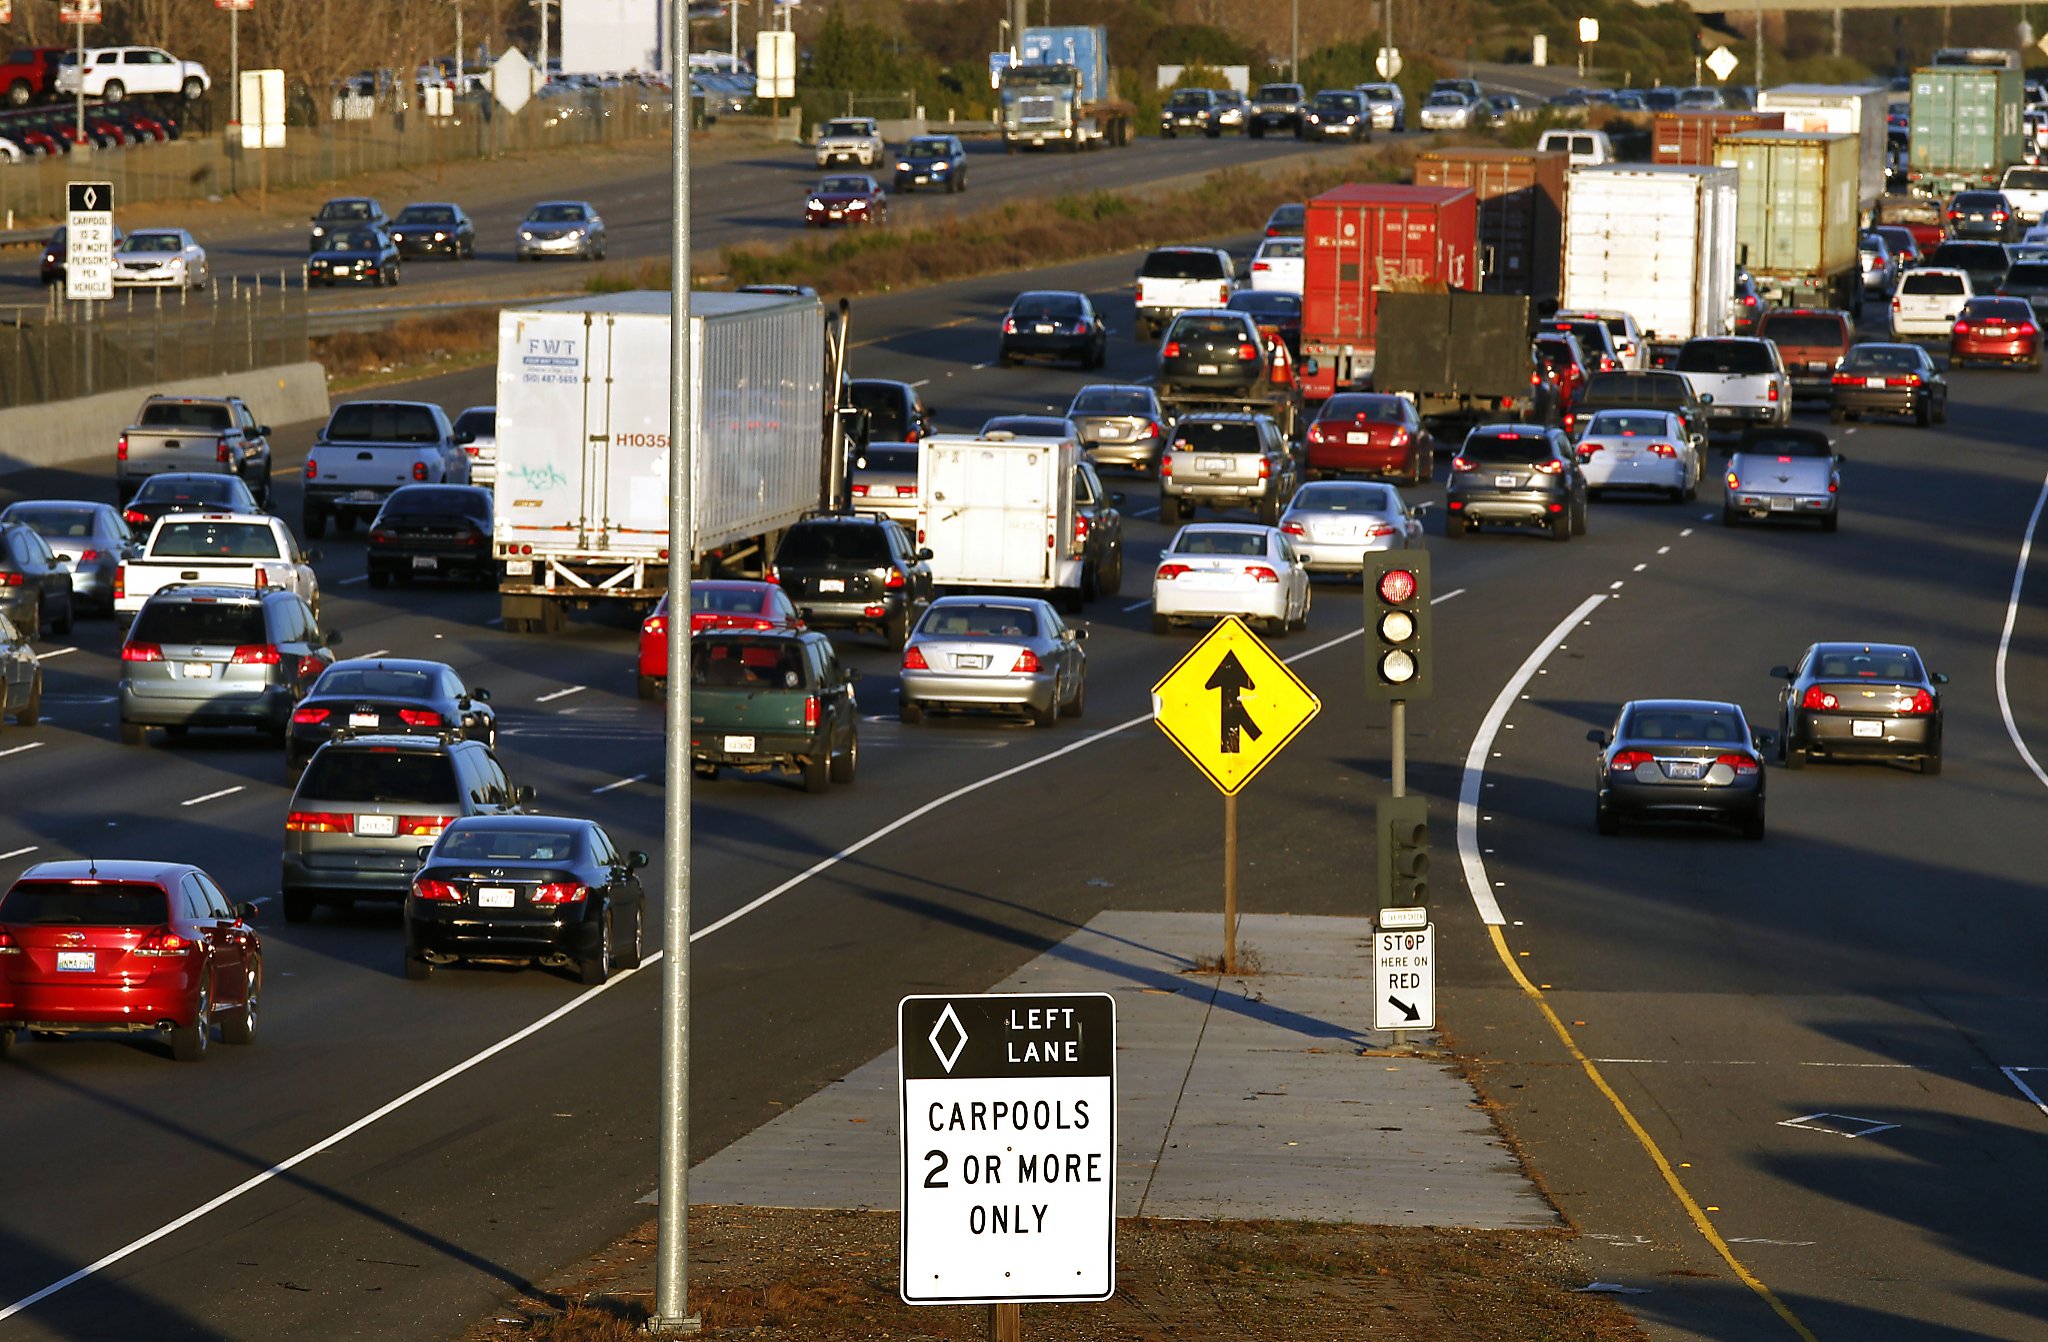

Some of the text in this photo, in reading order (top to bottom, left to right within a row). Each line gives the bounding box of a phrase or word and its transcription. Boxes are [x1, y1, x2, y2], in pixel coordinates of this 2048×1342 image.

[616, 432, 671, 447] H1035
[1384, 935, 1425, 950] STOP
[1381, 956, 1428, 967] HERE ON
[1389, 973, 1420, 989] RED
[1011, 1008, 1074, 1030] LEFT
[1008, 1041, 1078, 1063] LANE
[929, 1100, 1090, 1132] CARPOOLS
[924, 1149, 1102, 1188] 2 OR MORE
[970, 1204, 1048, 1235] ONLY
